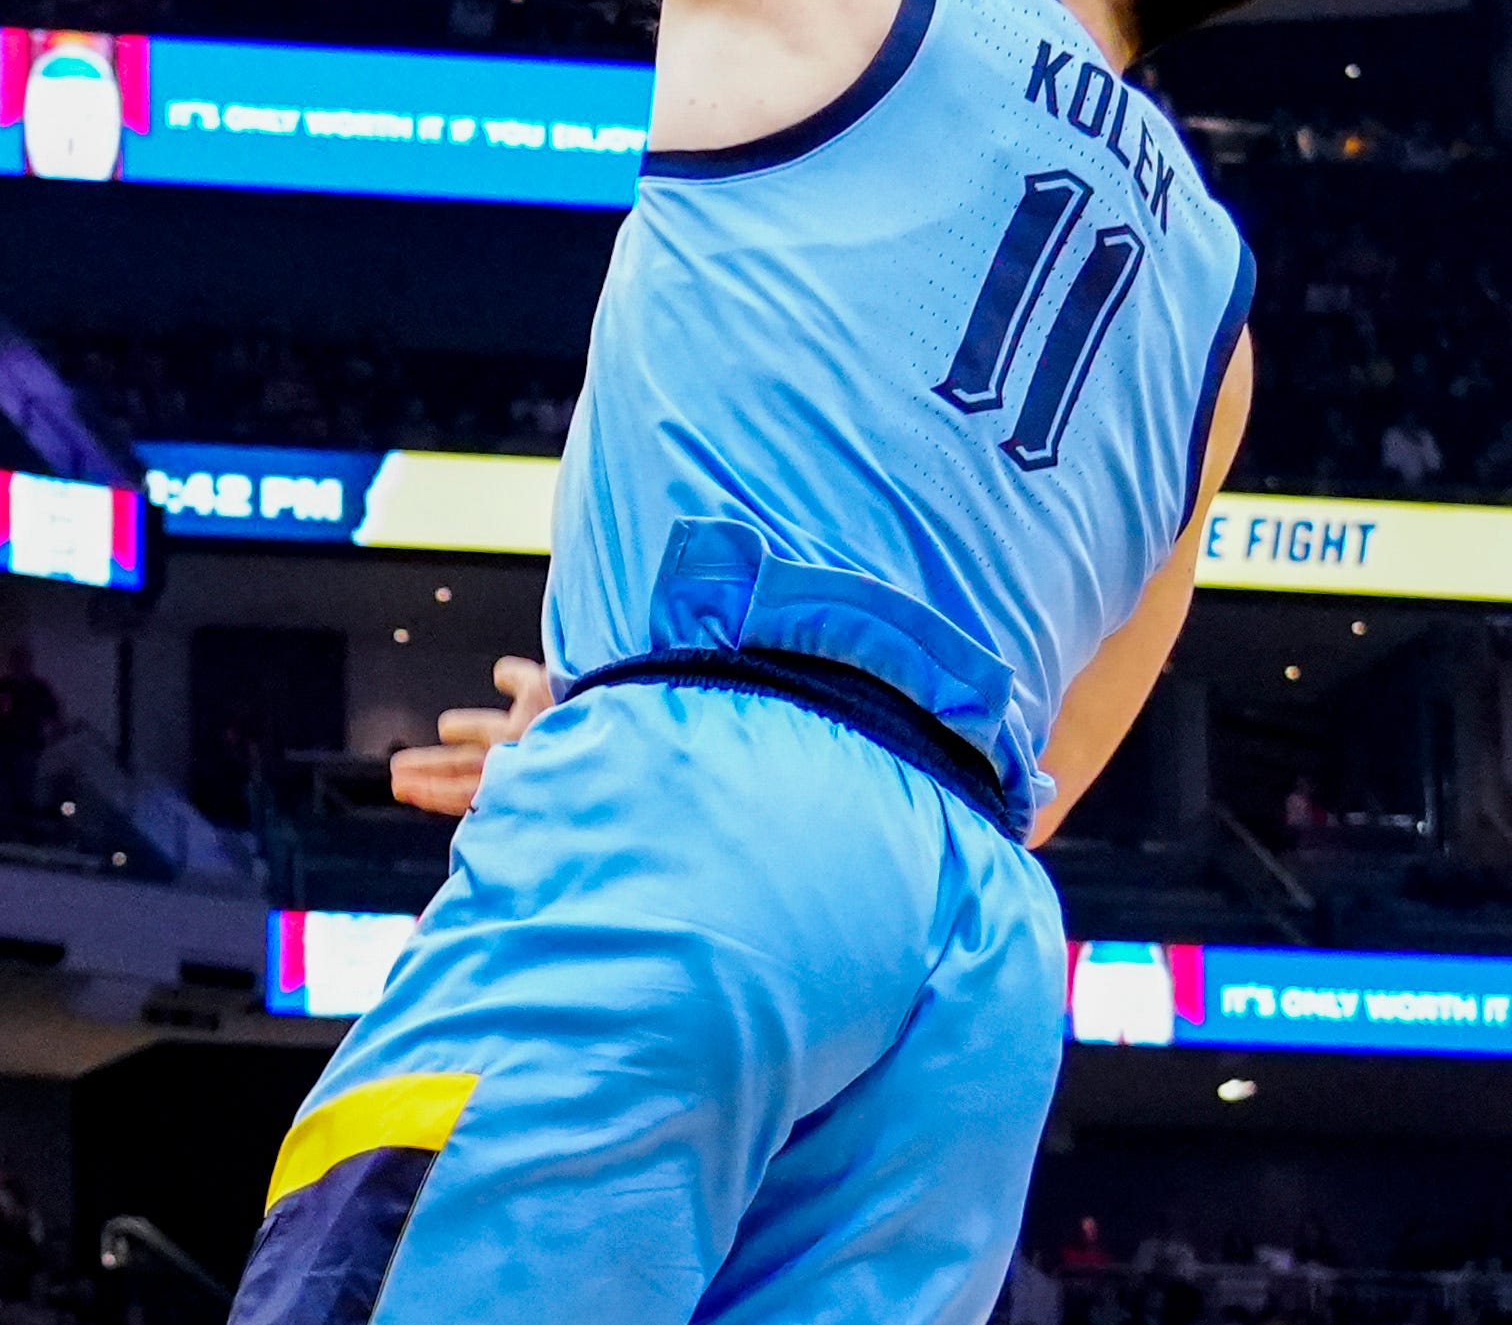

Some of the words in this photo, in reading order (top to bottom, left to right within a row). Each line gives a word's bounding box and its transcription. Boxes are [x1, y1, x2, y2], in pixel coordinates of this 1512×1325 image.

[1024, 40, 1175, 236] KOLEK
[930, 169, 1145, 472] 11
[260, 476, 344, 522] PM
[1244, 515, 1377, 567] FIGHT
[1219, 983, 1277, 1020] IT'S
[1279, 984, 1361, 1022] ONLY
[1363, 989, 1479, 1026] WORTH
